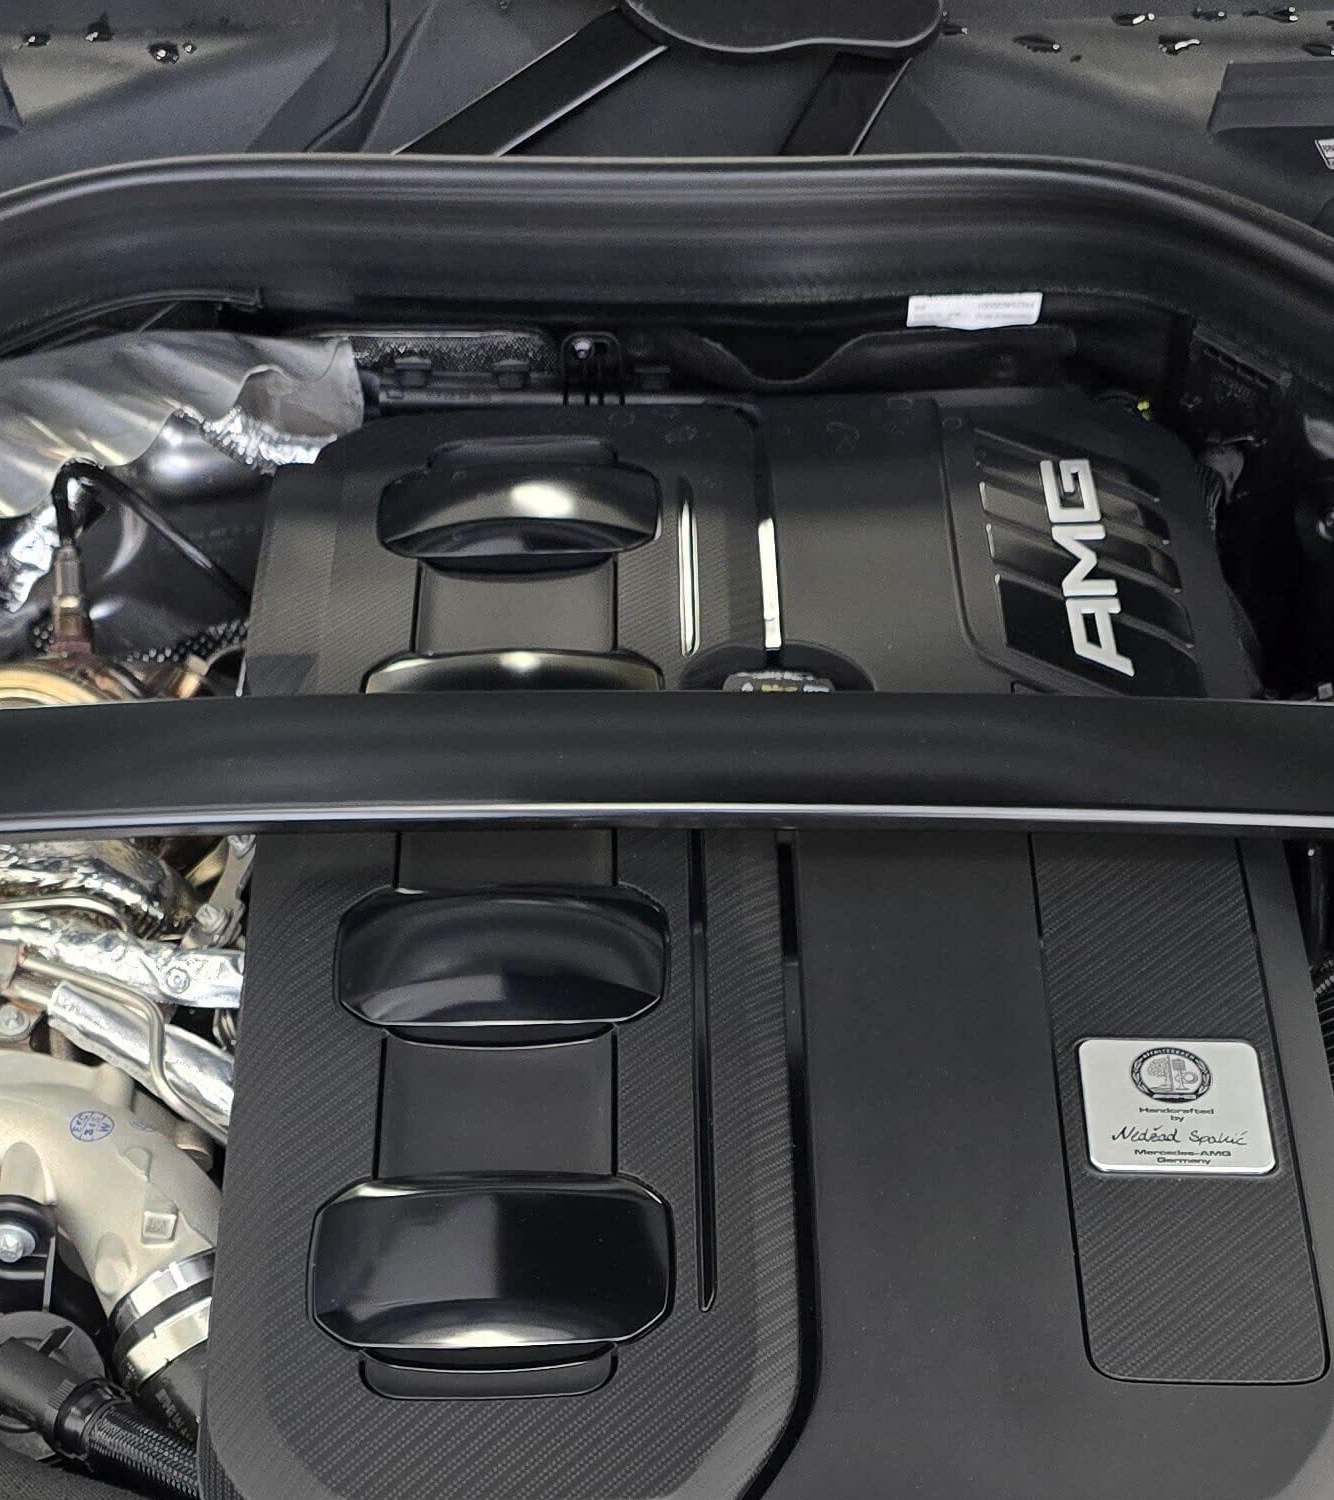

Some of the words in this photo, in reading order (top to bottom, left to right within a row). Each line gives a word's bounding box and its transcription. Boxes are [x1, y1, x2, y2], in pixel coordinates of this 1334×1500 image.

[1040, 459, 1135, 677] AMG
[1139, 1107, 1214, 1115] Handcrafted
[1134, 1149, 1231, 1157] Mercedes-AMG
[1157, 1157, 1211, 1165] Germany
